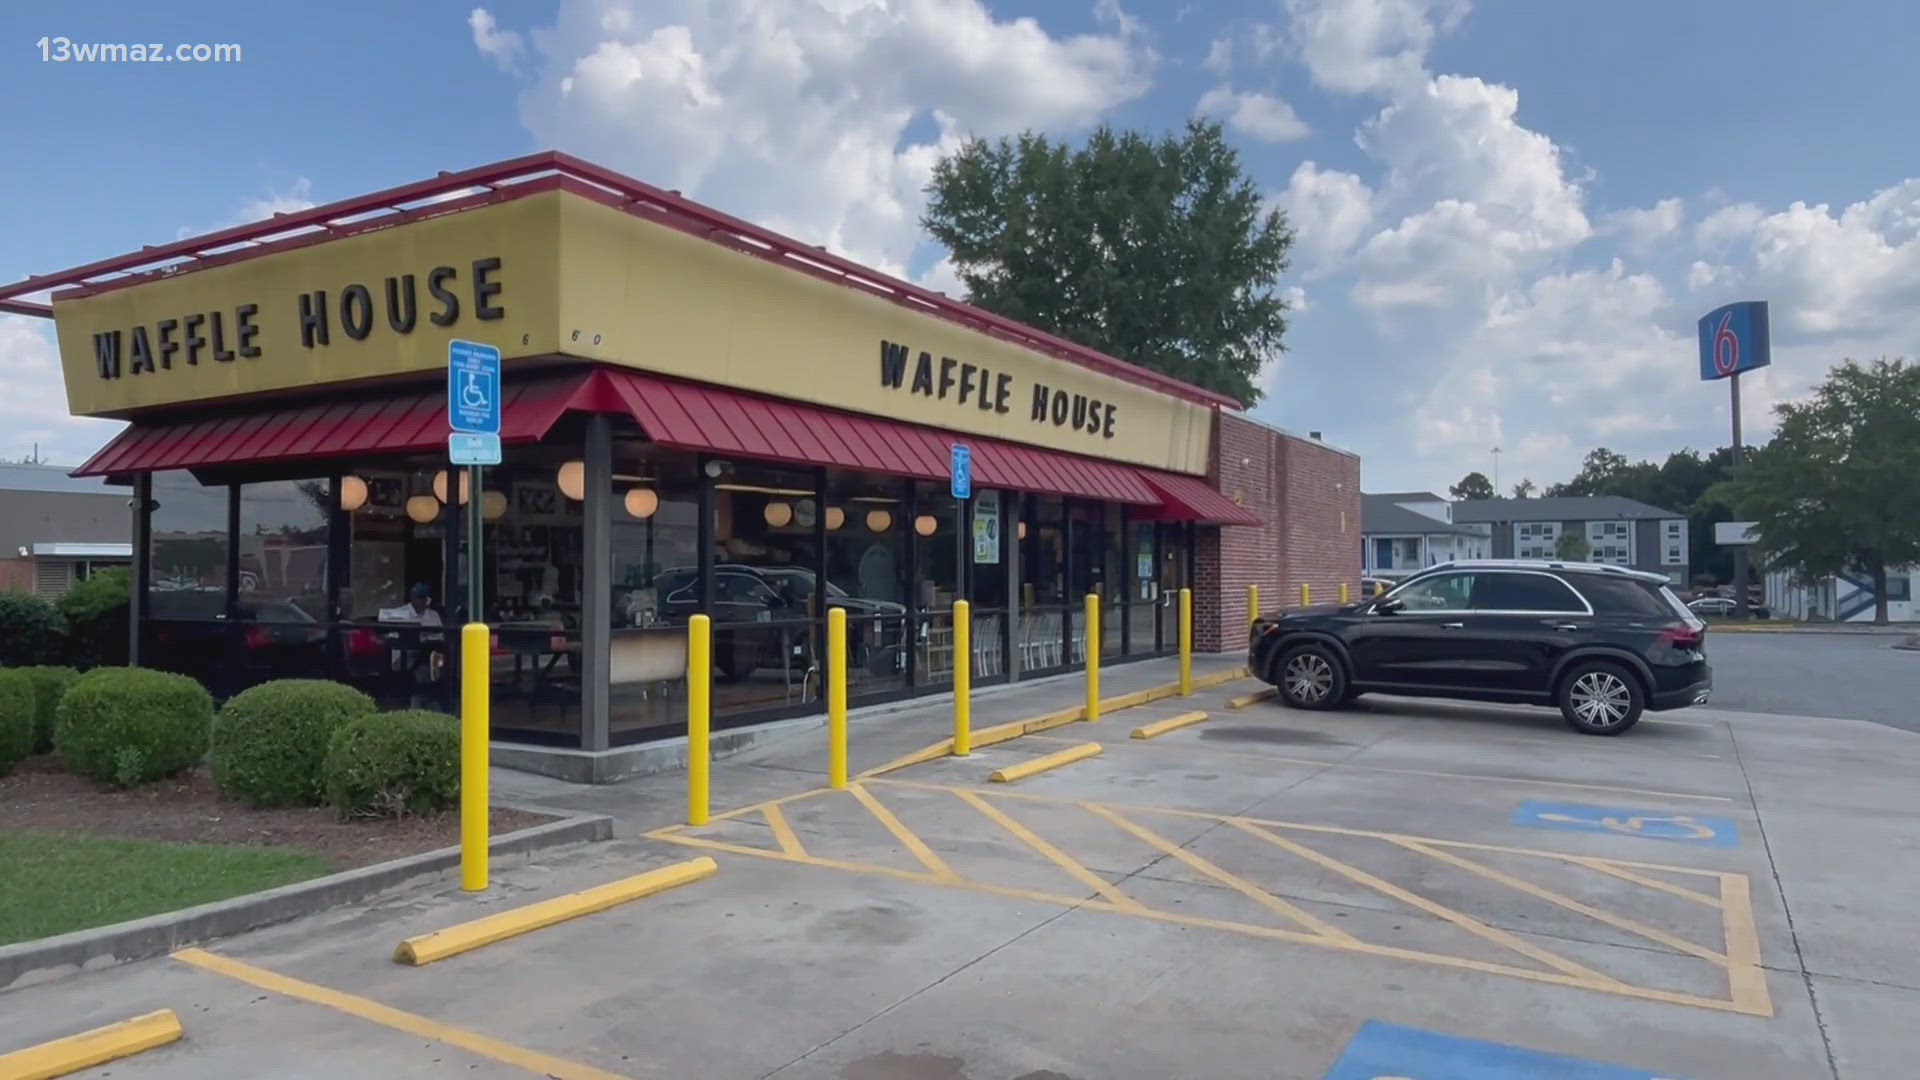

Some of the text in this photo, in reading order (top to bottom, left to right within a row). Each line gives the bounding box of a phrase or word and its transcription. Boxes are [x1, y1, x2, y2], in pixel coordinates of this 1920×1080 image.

[93, 256, 505, 380] WAFFLE HOUSE
[522, 333, 529, 346] 6
[1713, 311, 1739, 375] 6
[880, 339, 1117, 439] WAFFLE HOUSE
